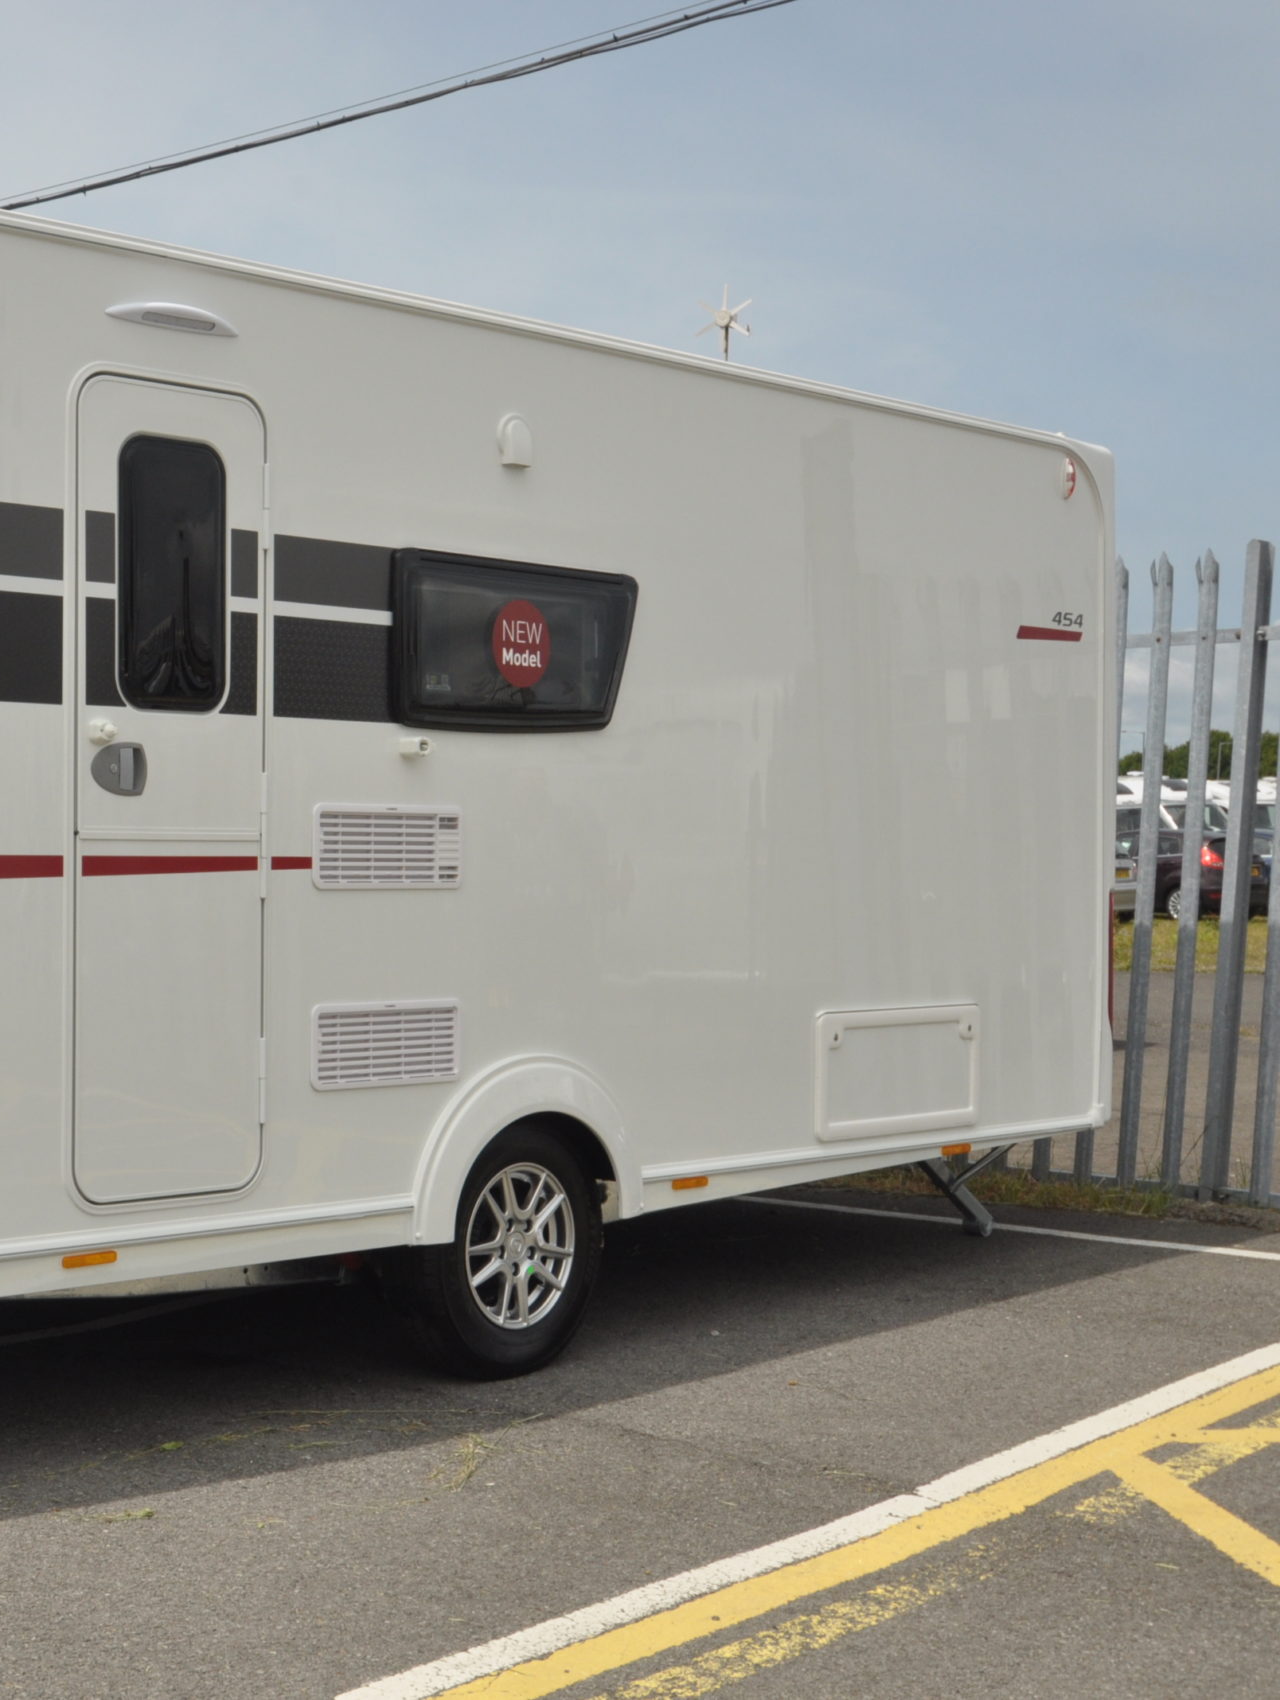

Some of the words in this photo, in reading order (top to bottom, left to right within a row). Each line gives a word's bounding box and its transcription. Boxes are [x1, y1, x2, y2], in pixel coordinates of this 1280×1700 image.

[1051, 611, 1084, 629] 454
[501, 618, 543, 645] NEW
[501, 647, 542, 668] Model
